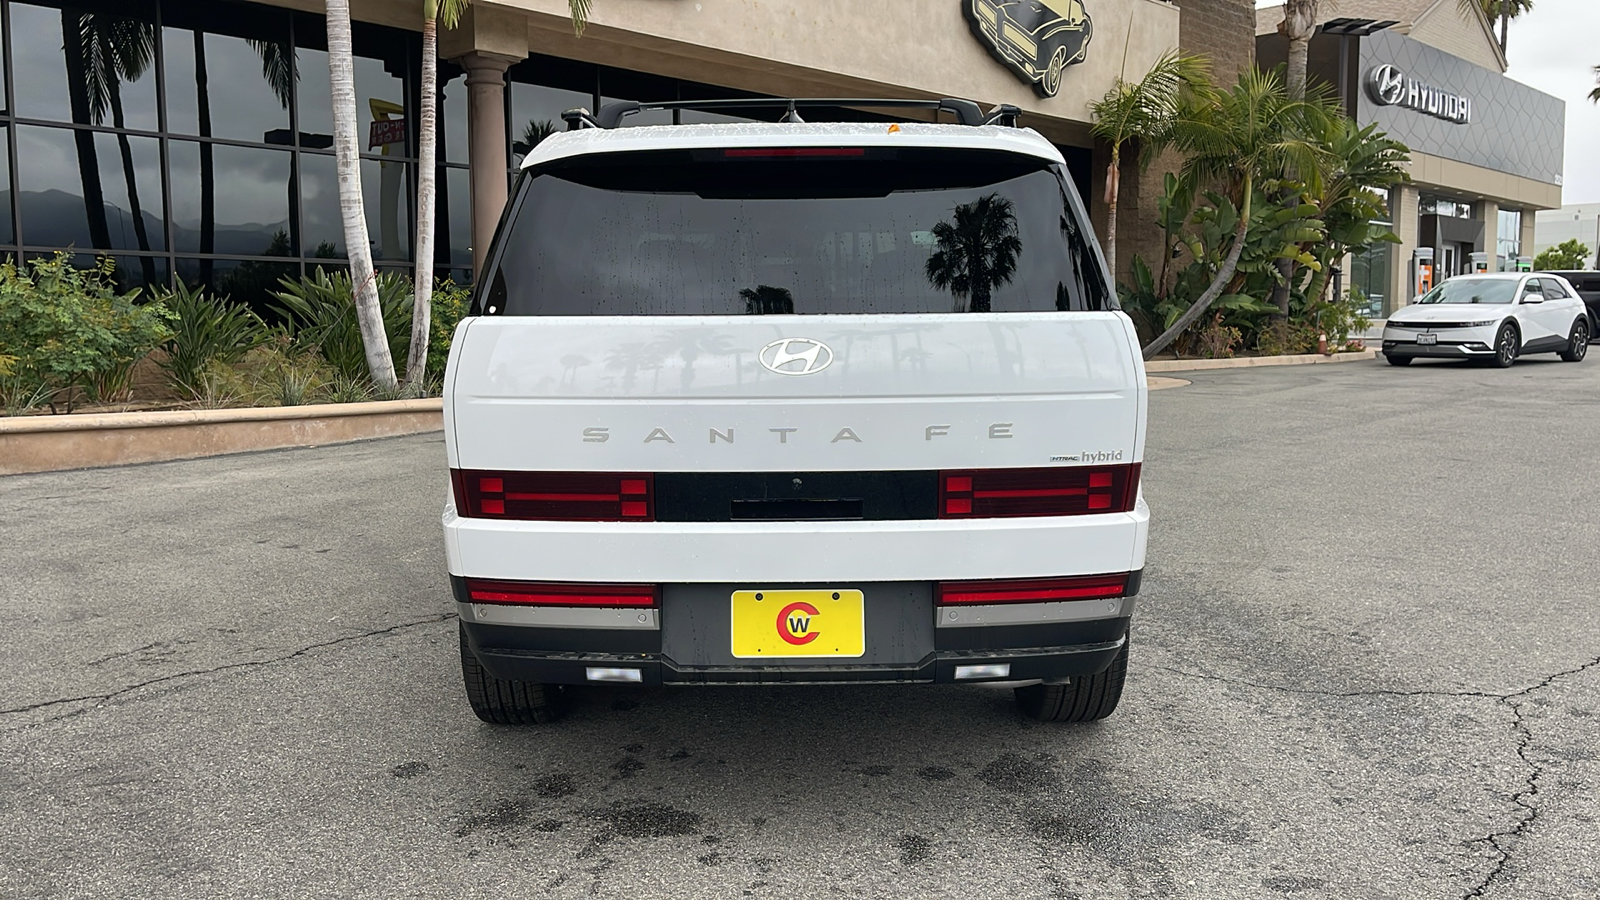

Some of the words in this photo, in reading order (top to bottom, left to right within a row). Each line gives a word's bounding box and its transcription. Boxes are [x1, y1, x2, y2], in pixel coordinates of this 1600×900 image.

[1408, 78, 1471, 123] HYUNDAI
[582, 427, 863, 443] SANTA
[925, 423, 1013, 441] FE
[1081, 449, 1123, 463] hybrid
